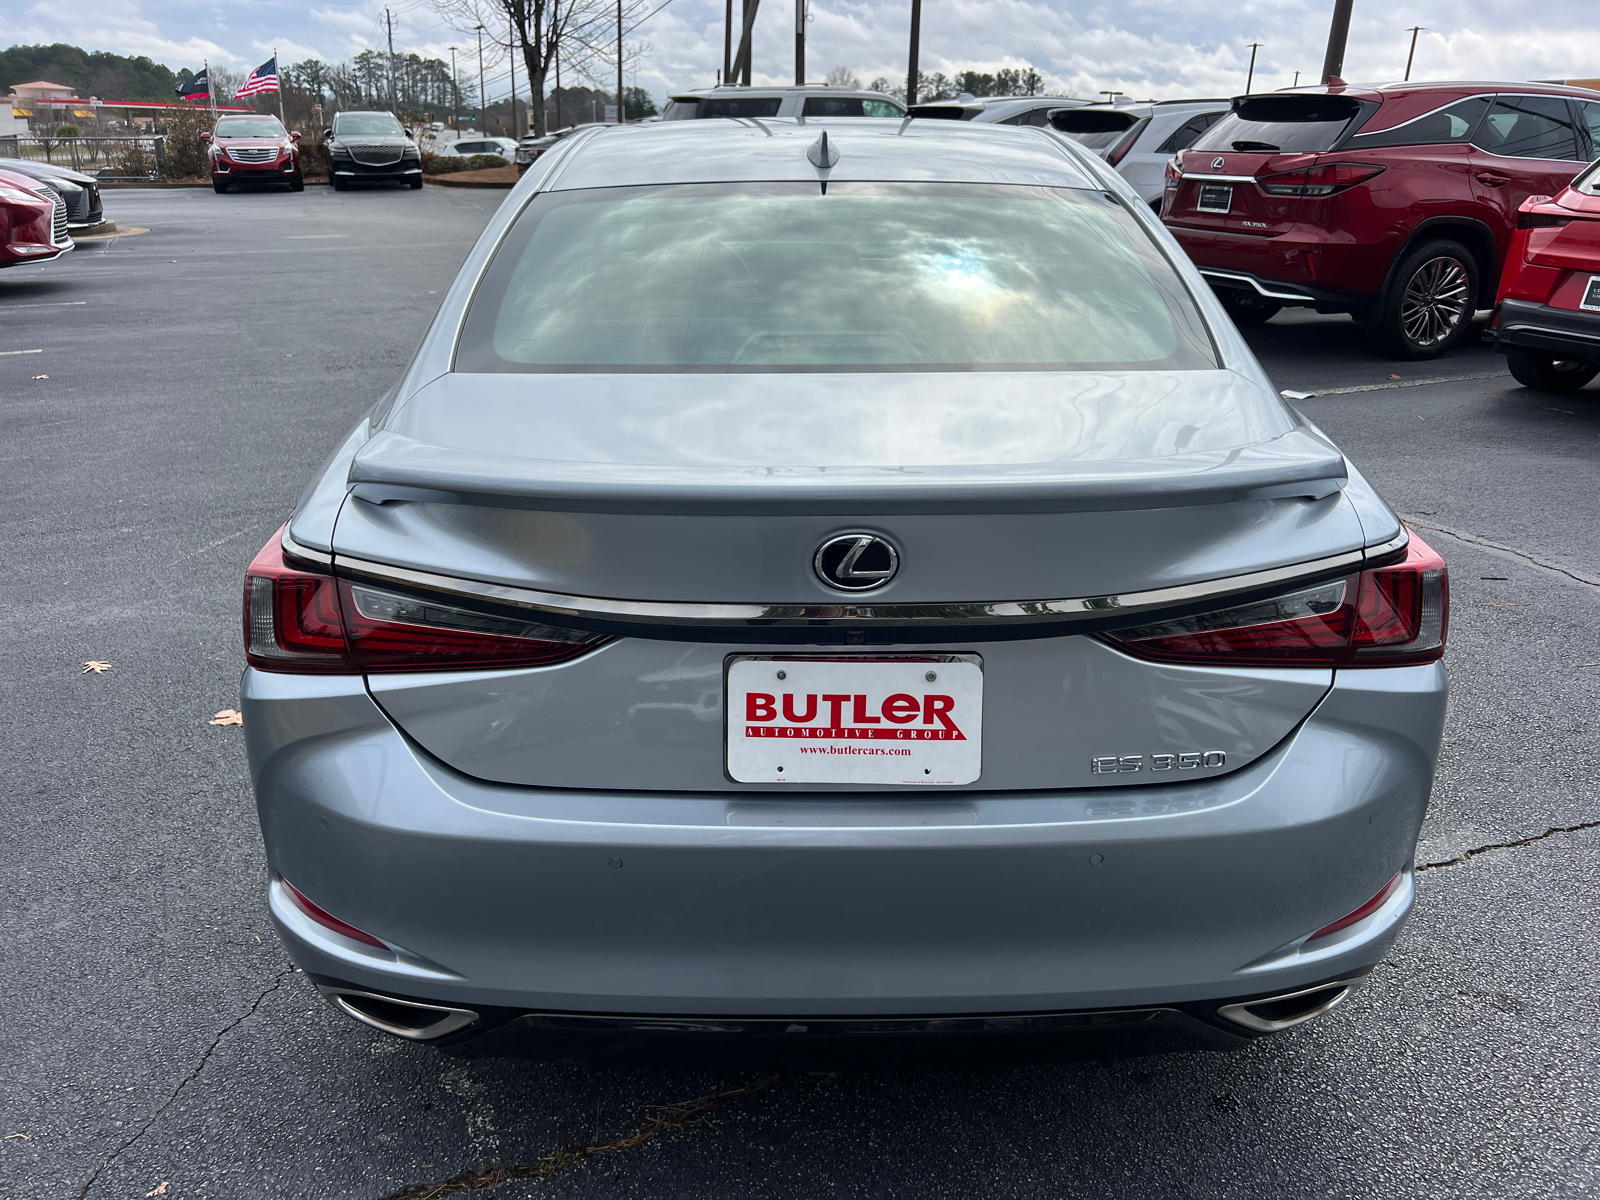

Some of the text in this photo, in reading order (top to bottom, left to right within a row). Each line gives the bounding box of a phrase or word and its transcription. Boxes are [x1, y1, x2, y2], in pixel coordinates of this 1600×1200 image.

[746, 727, 959, 740] AUTOMOTIVE GROUP
[800, 745, 911, 757] www.butlercars.com
[1092, 750, 1227, 775] ES 350
